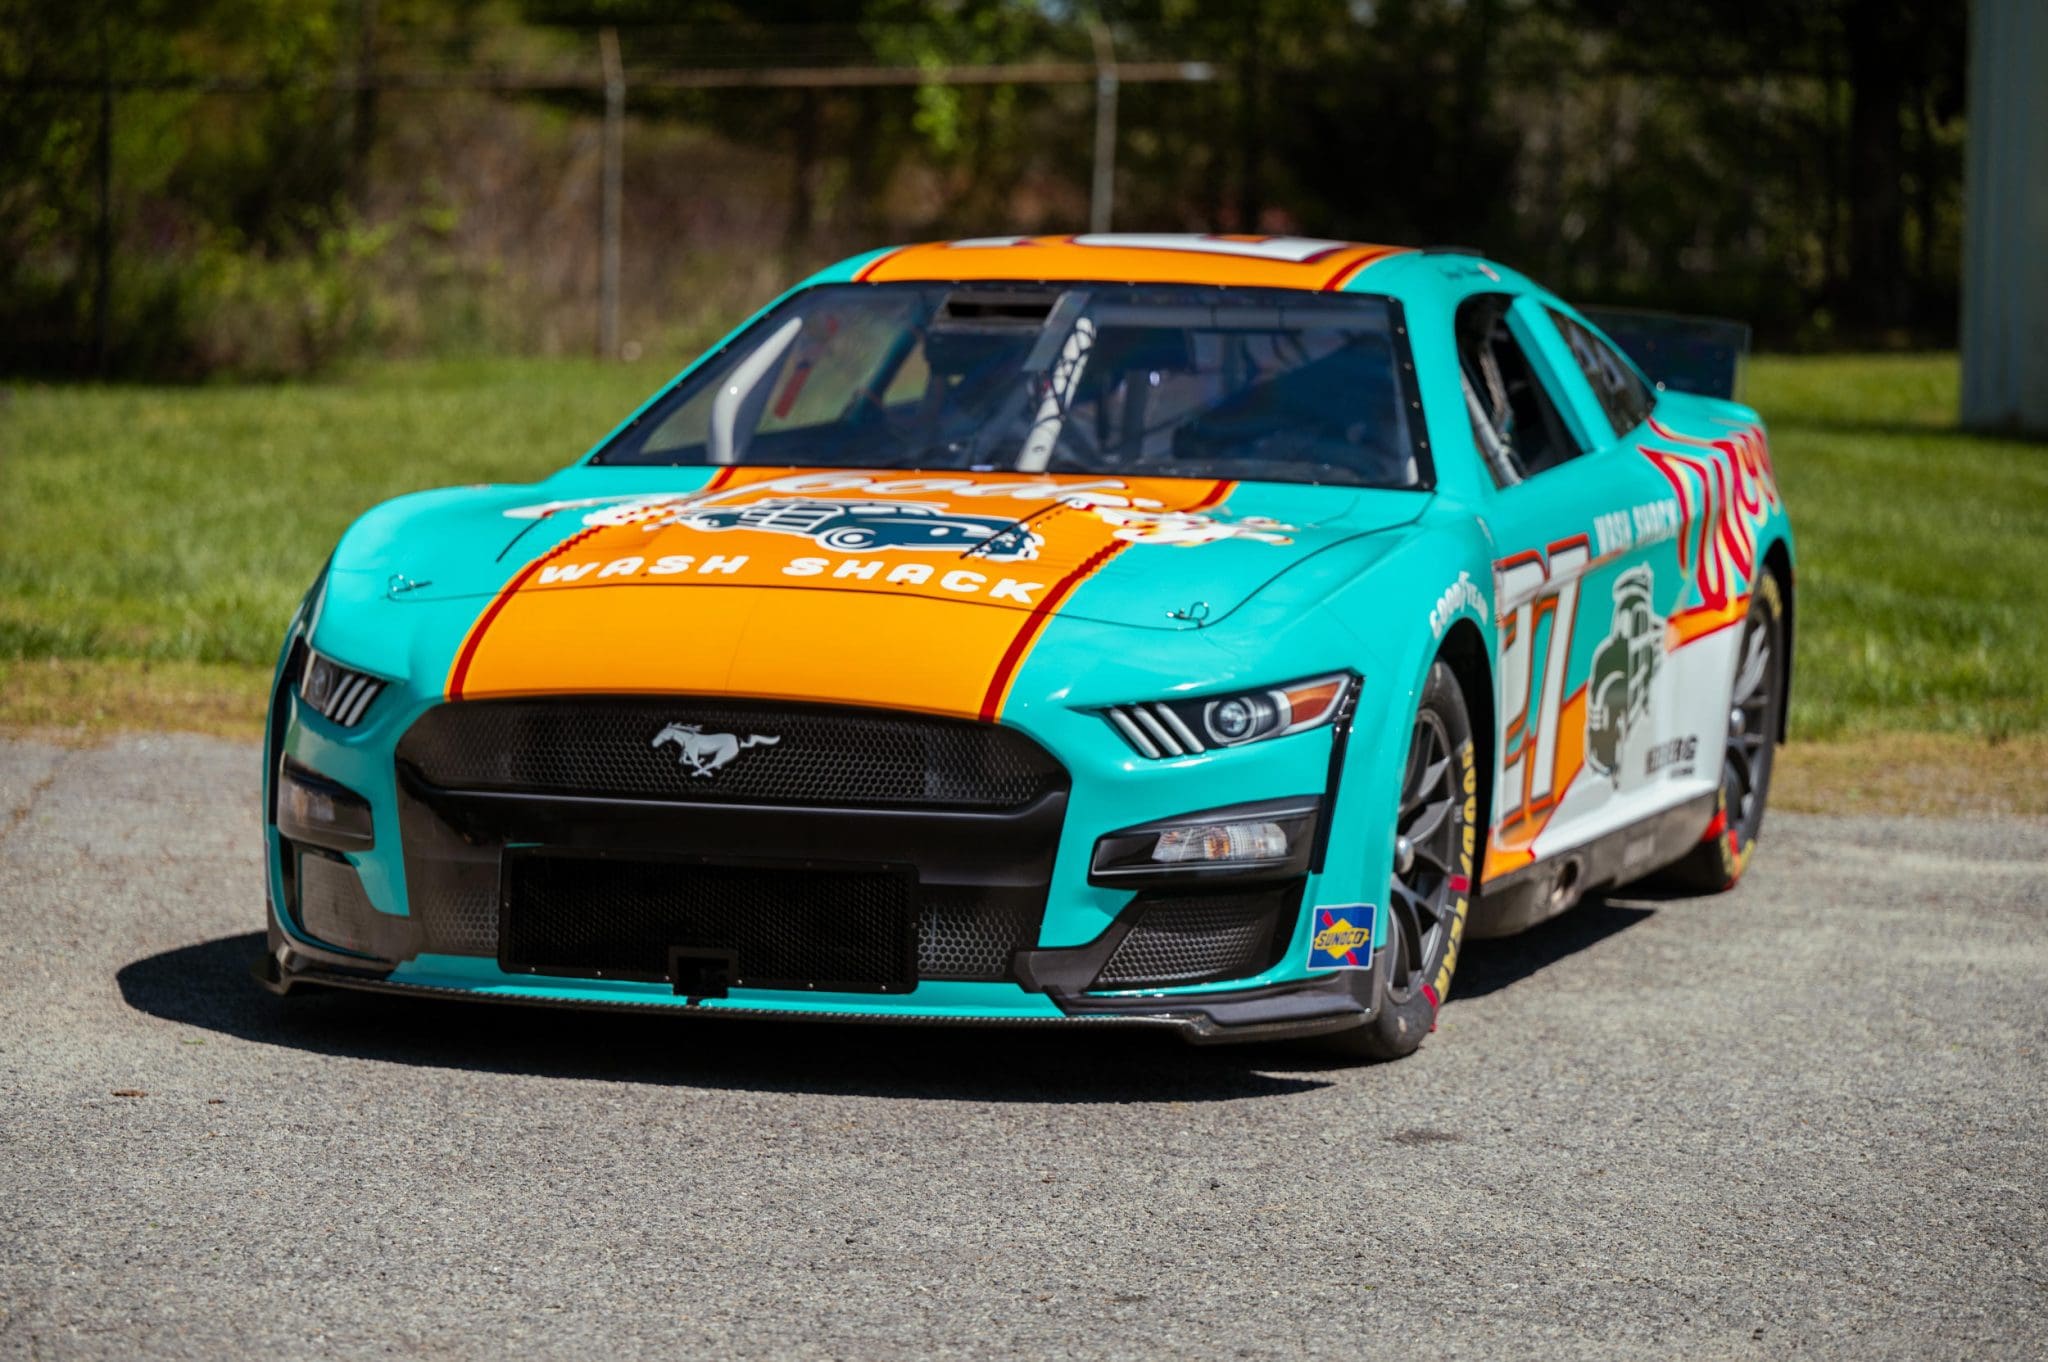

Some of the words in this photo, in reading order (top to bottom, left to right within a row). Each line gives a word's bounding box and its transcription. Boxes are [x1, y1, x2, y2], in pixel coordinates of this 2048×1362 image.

[538, 555, 750, 584] WASH
[781, 557, 1045, 604] SHACK
[1316, 930, 1366, 947] SUNOCO
